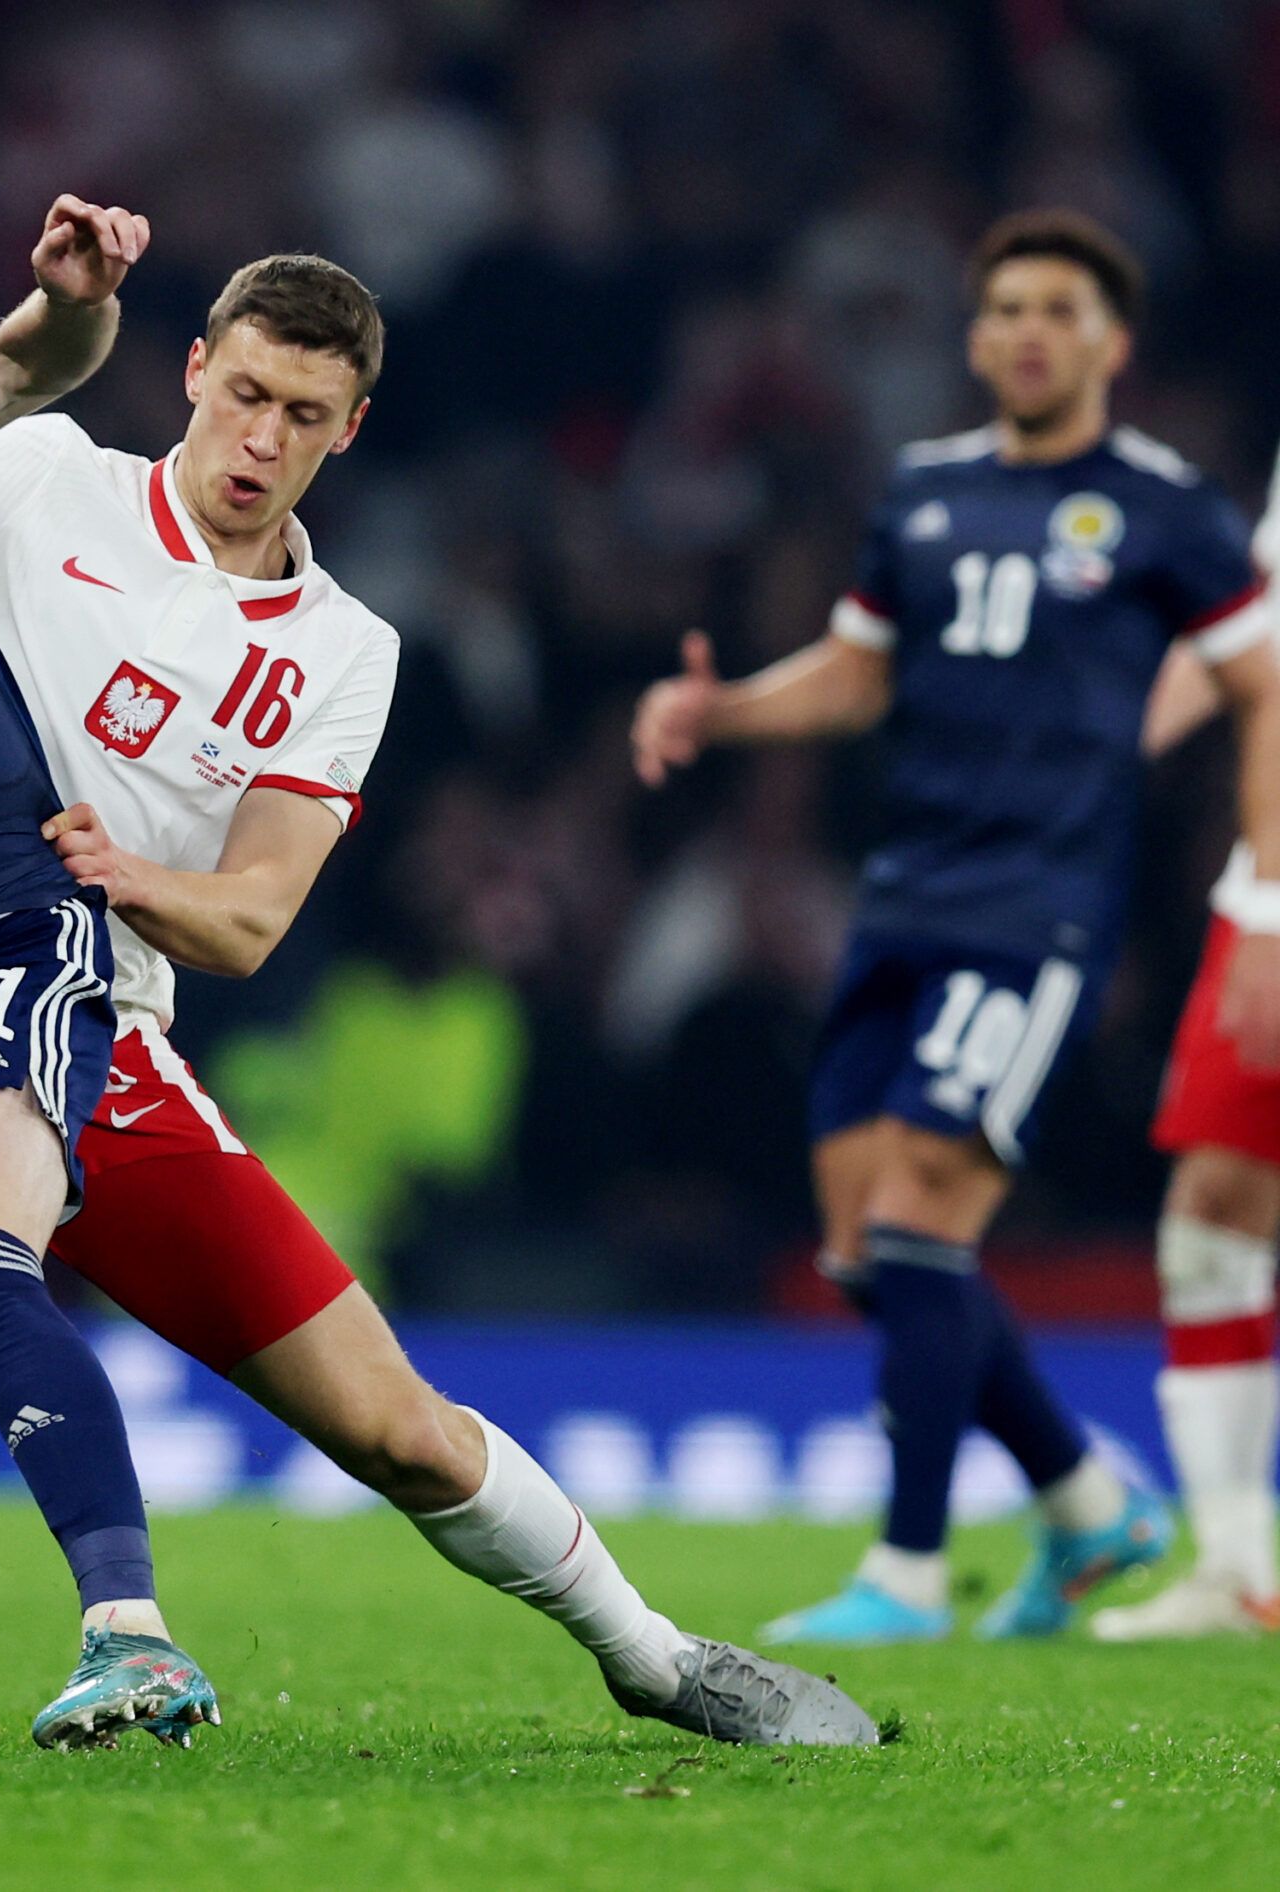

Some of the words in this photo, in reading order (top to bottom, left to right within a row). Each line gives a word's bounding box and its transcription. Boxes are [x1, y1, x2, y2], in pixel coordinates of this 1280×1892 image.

[941, 550, 1037, 658] 10
[211, 642, 306, 749] 16
[191, 753, 219, 775] SCOTLAND
[220, 772, 242, 788] POLAND
